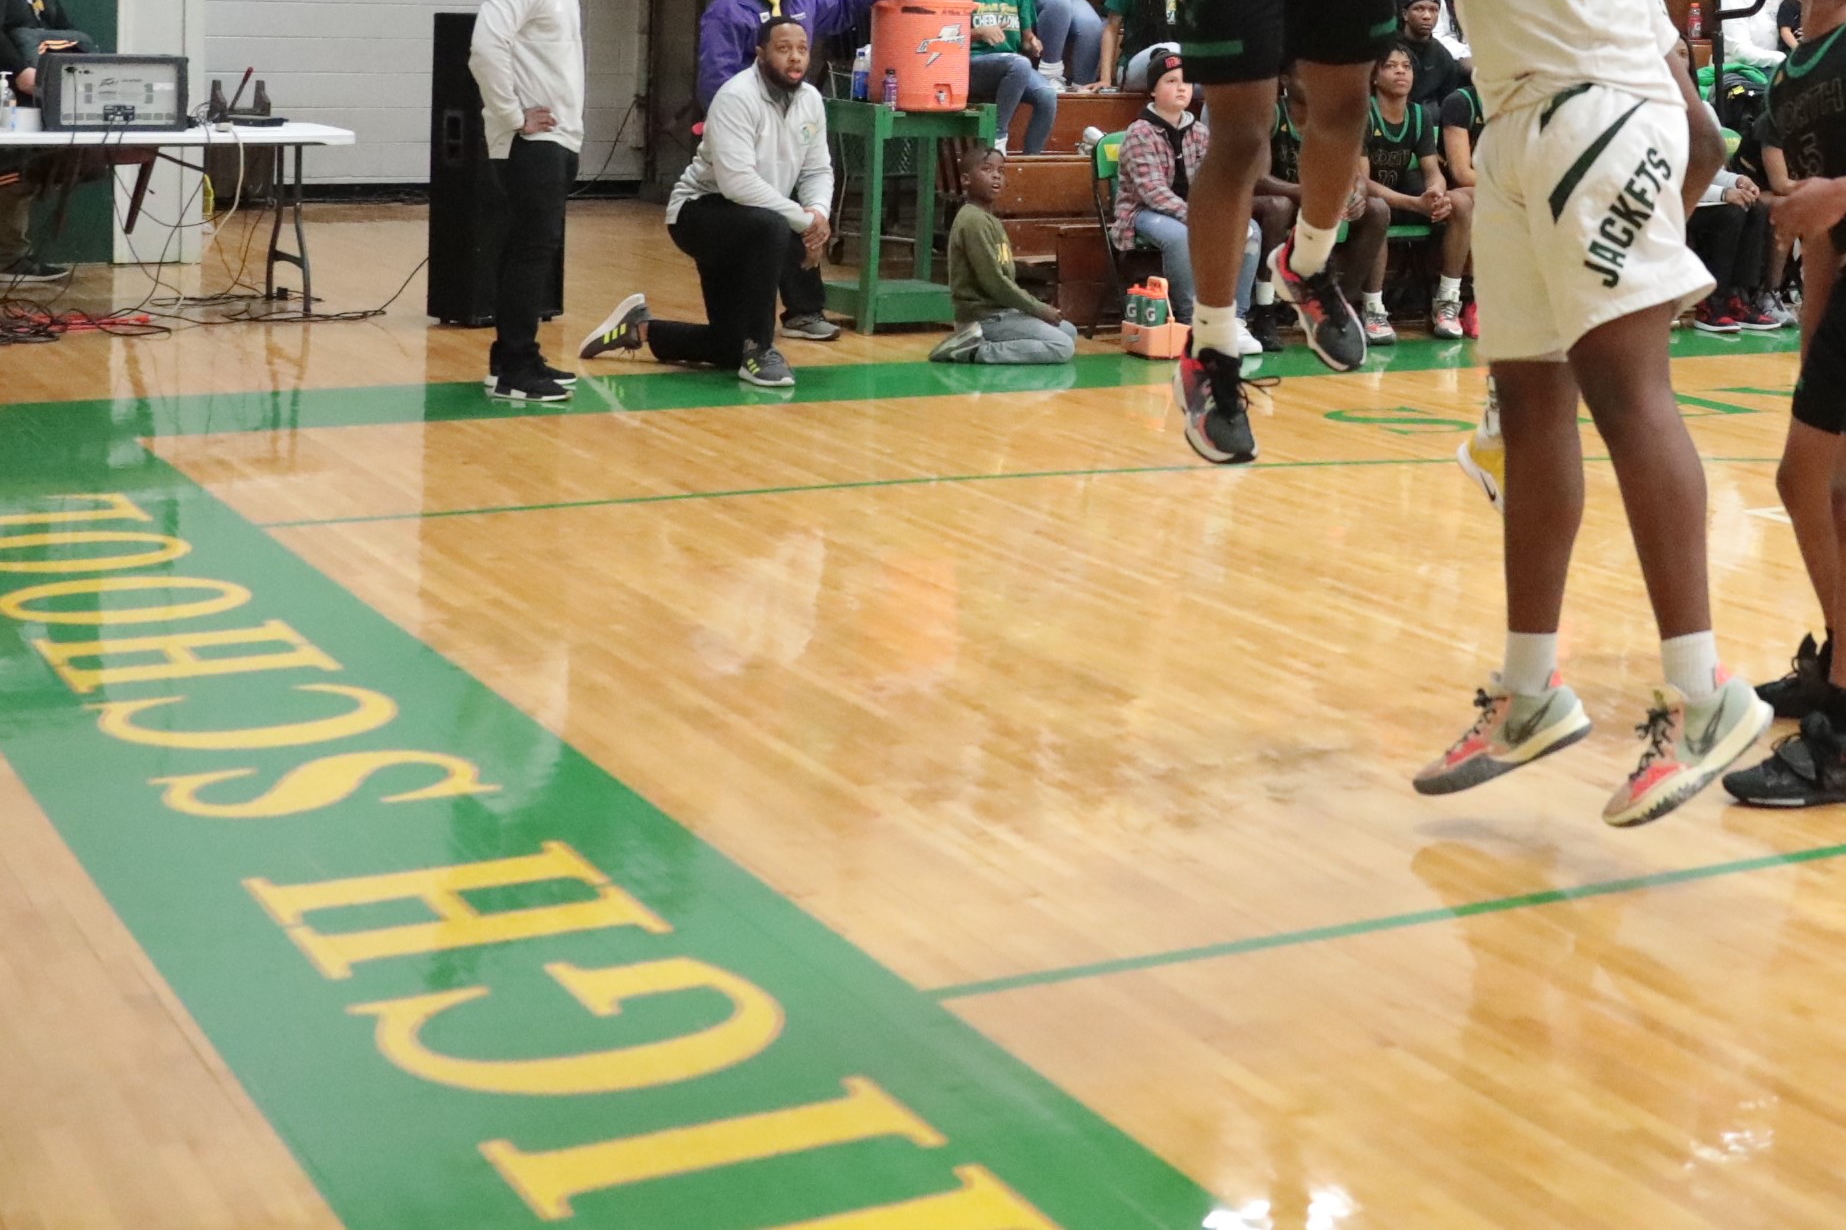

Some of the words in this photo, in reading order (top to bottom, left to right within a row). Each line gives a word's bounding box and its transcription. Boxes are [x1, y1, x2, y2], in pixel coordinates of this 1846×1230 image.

[1583, 147, 1672, 289] JACKETS
[1126, 303, 1137, 318] G
[1146, 307, 1156, 322] G
